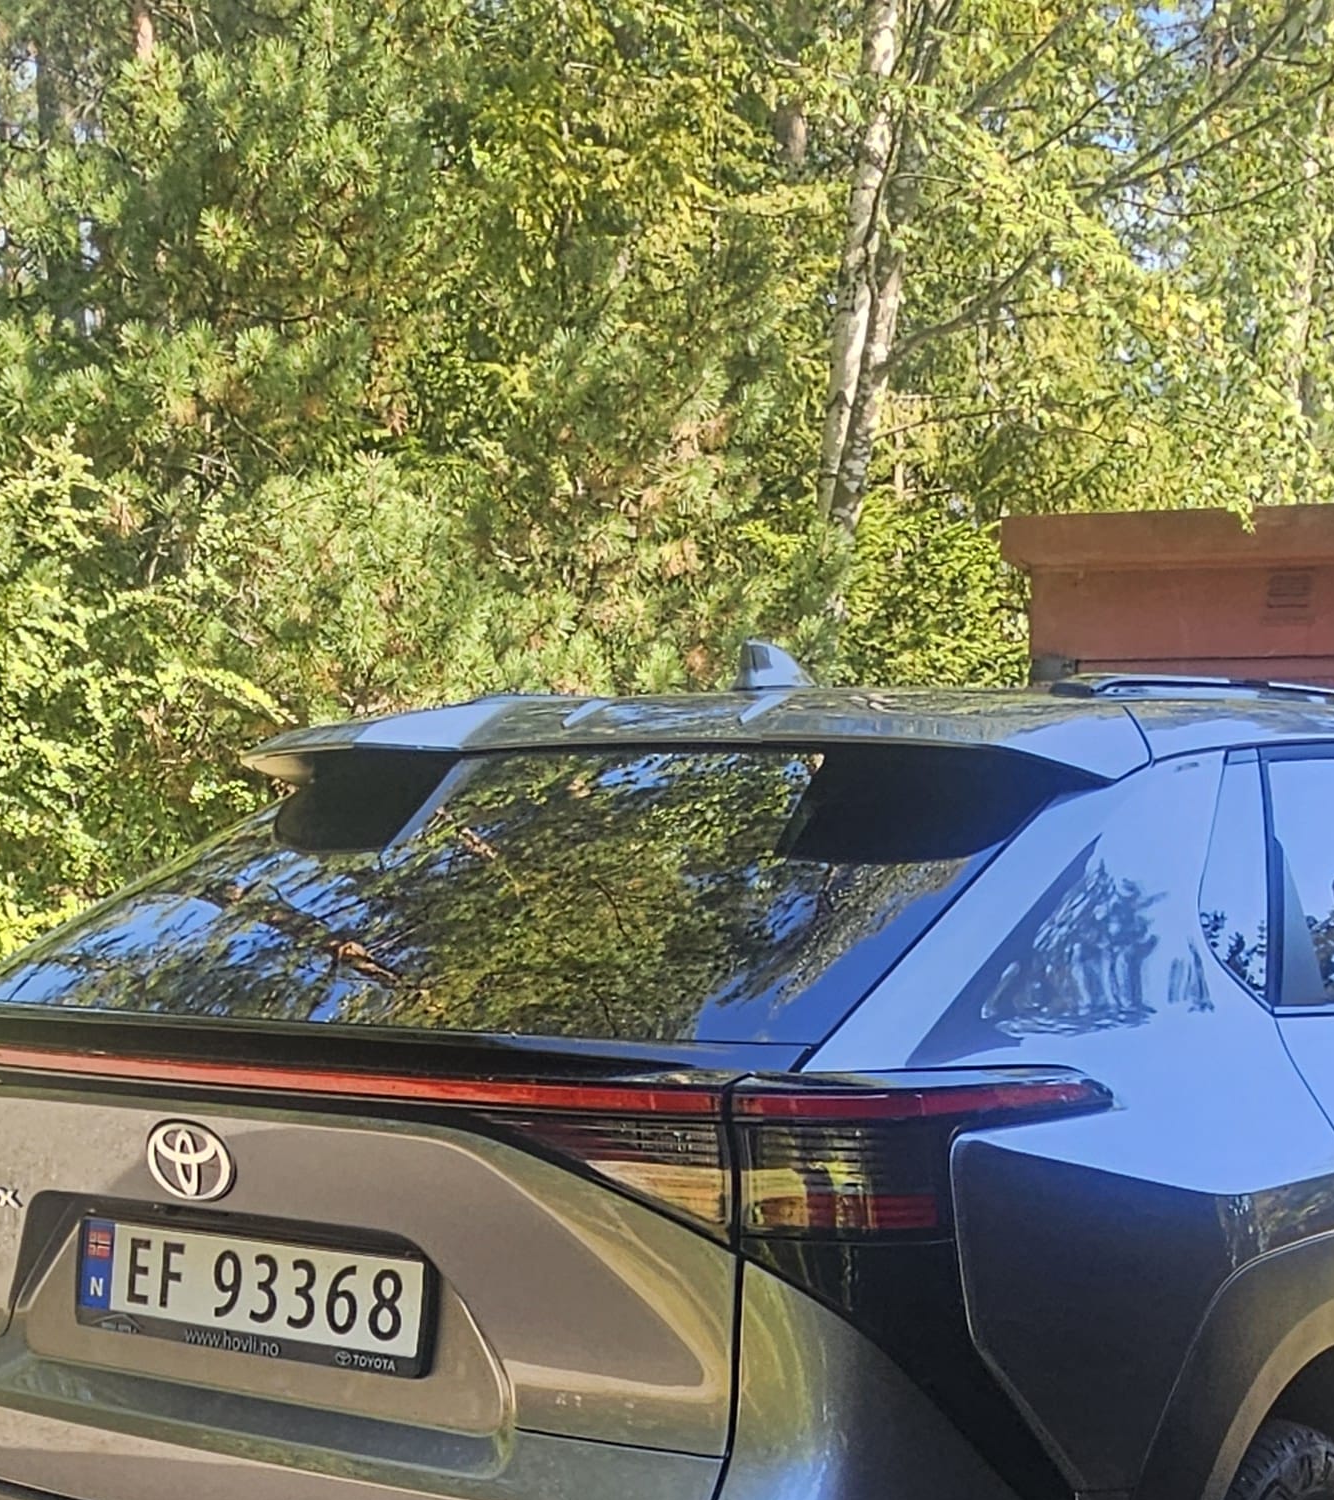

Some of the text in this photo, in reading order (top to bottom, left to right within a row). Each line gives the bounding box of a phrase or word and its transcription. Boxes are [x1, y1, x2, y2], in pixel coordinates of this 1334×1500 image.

[89, 1276, 103, 1297] N
[126, 1237, 403, 1341] EF 93368
[185, 1329, 280, 1357] www.hovli.no
[353, 1354, 396, 1372] TOYOTA
